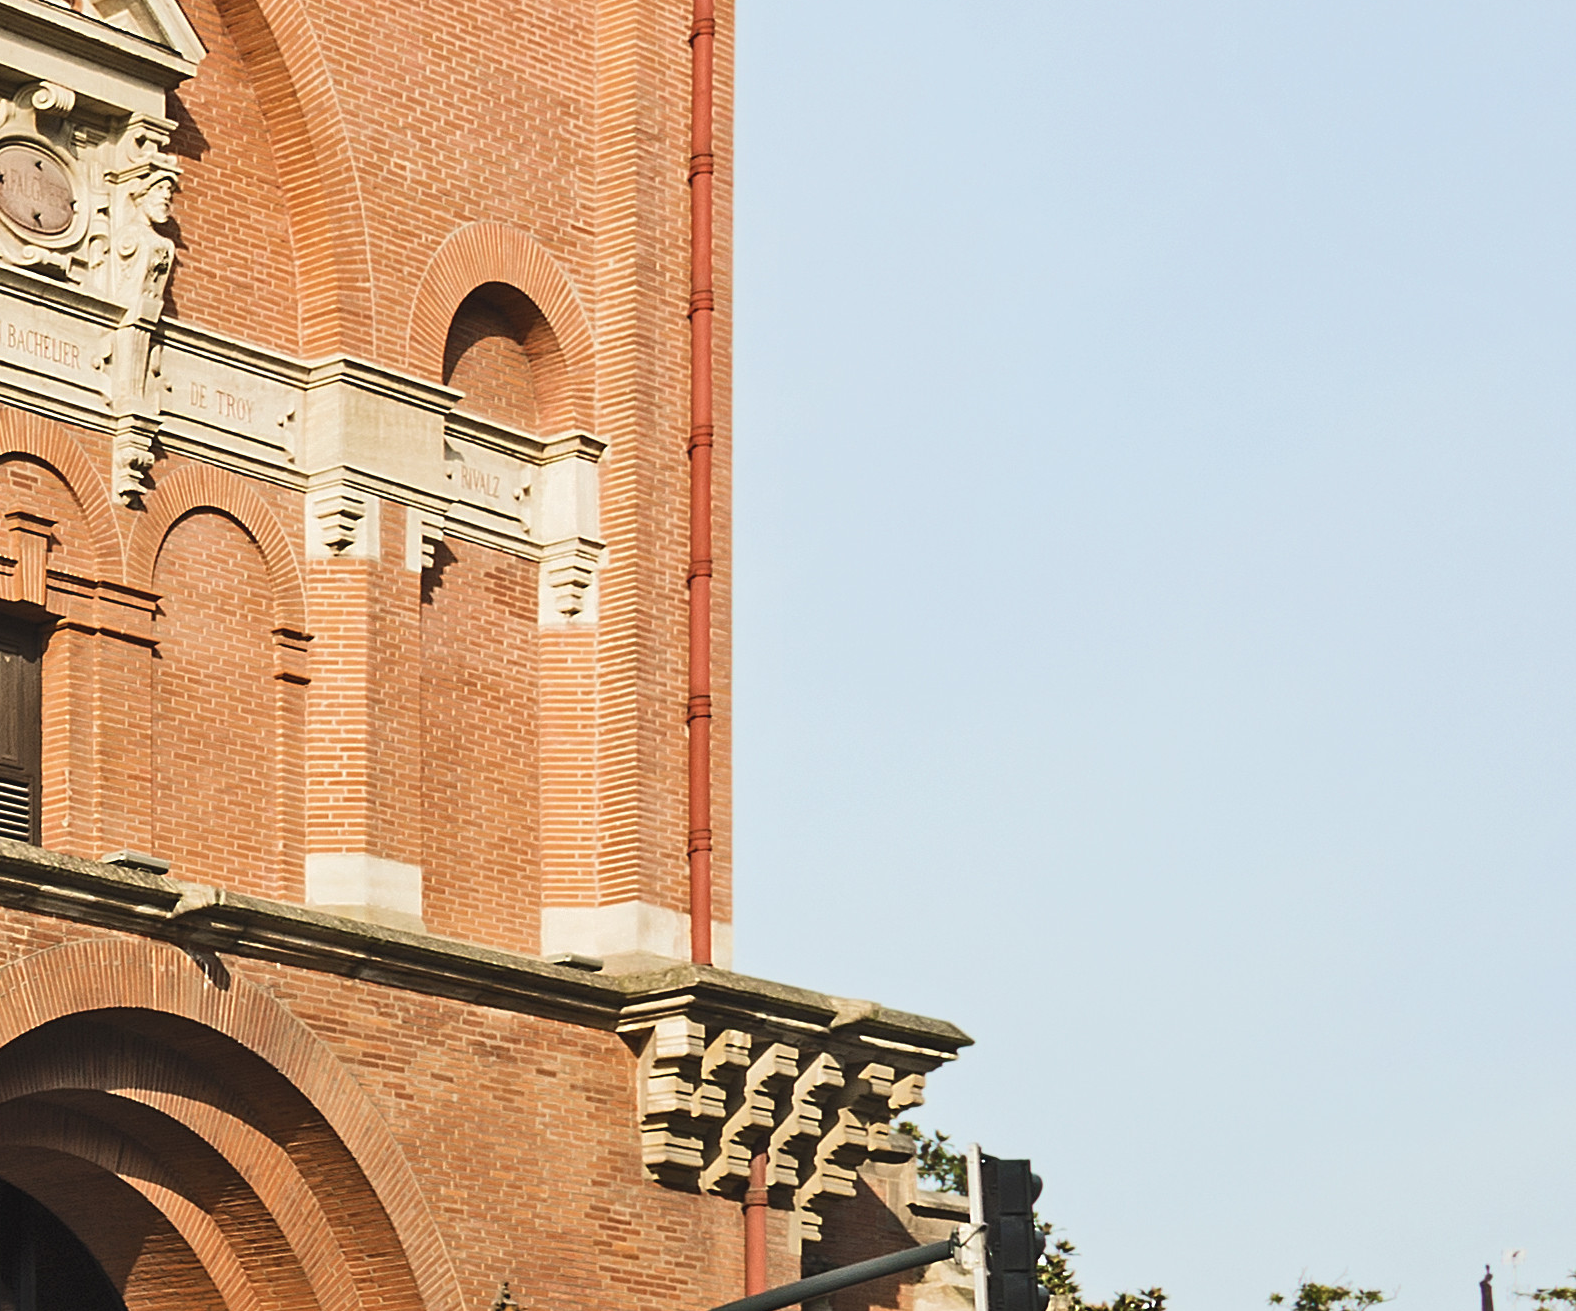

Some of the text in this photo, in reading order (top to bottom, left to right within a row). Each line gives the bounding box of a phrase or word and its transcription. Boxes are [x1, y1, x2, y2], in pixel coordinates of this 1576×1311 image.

[7, 323, 81, 370] BACHELIER
[190, 382, 253, 424] DE TROY
[461, 464, 500, 500] RIVALZ
